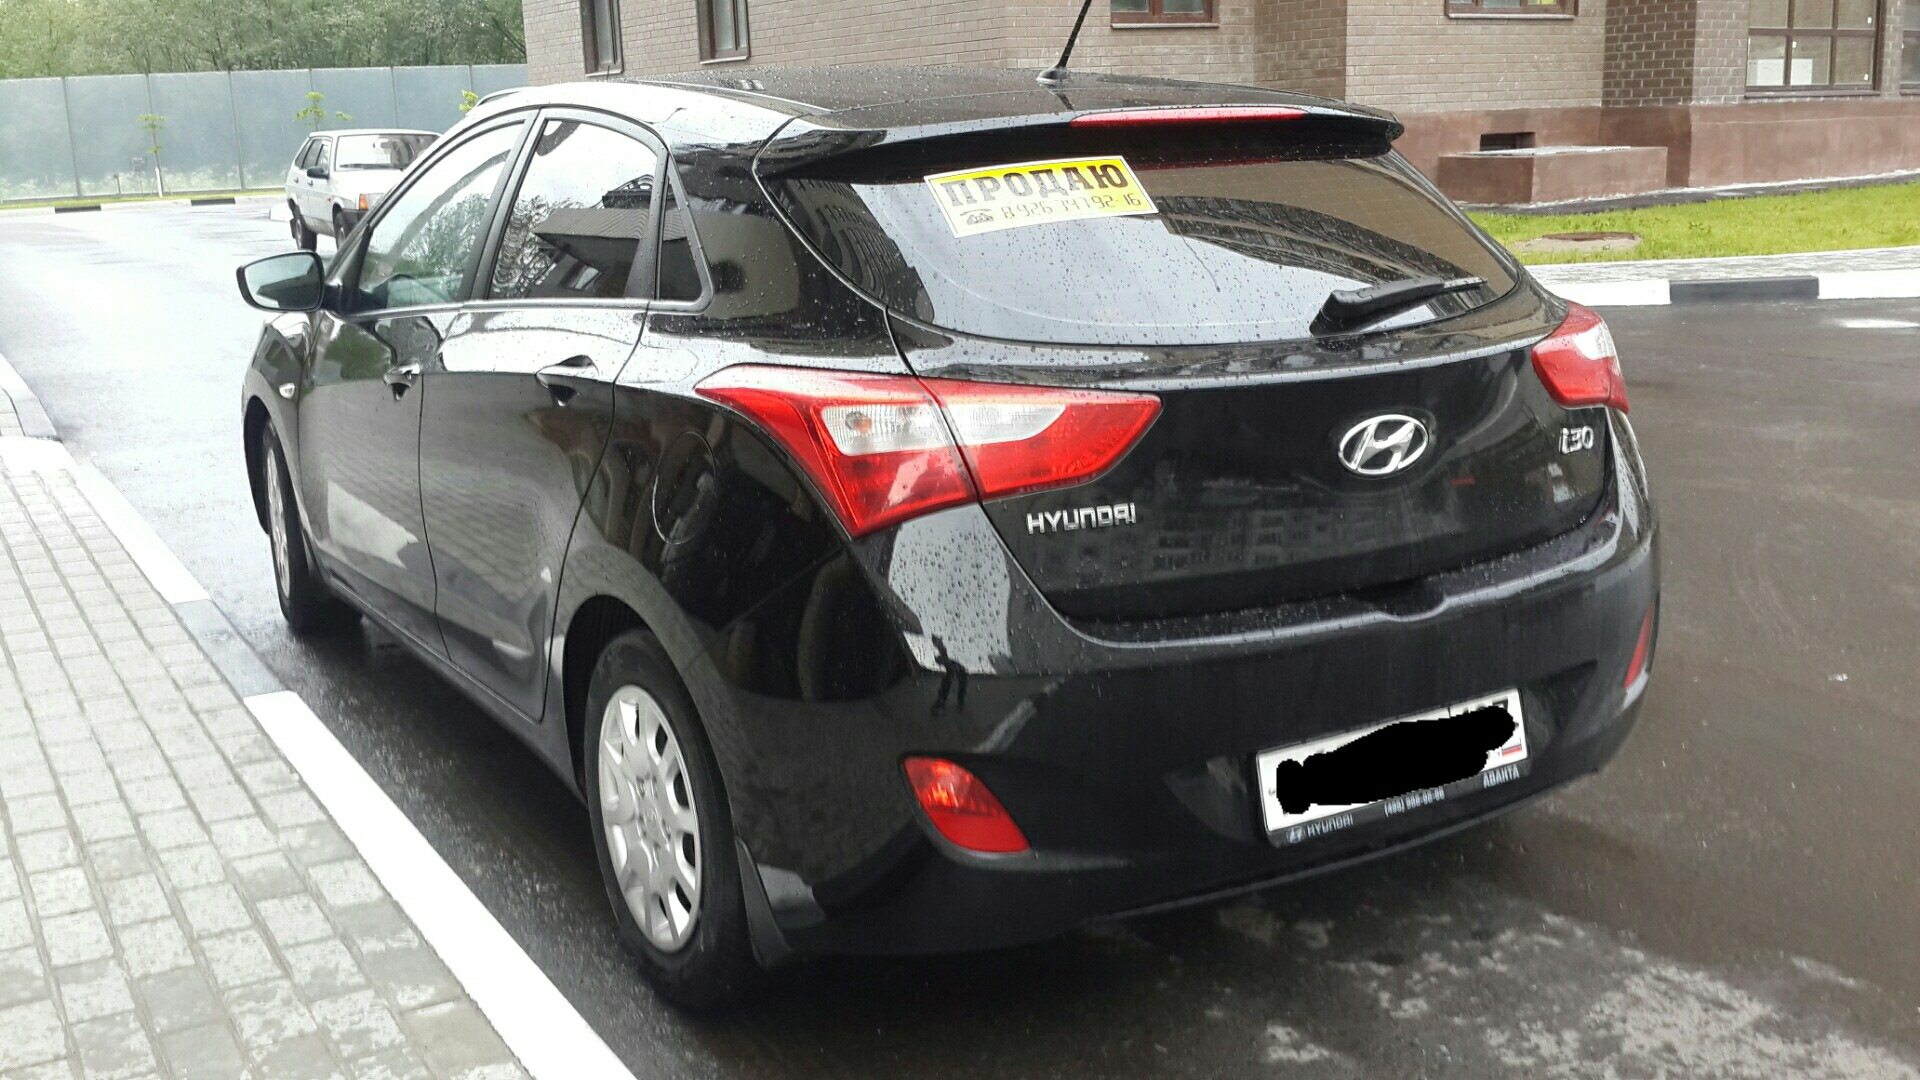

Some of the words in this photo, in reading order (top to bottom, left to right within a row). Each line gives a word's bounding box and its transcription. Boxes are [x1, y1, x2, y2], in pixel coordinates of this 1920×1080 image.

[940, 164, 1129, 207] ПРОДАЮ
[1001, 206, 1015, 220] 8
[1027, 502, 1137, 535] HYUNDAI
[1307, 812, 1354, 838] HYUNDAI
